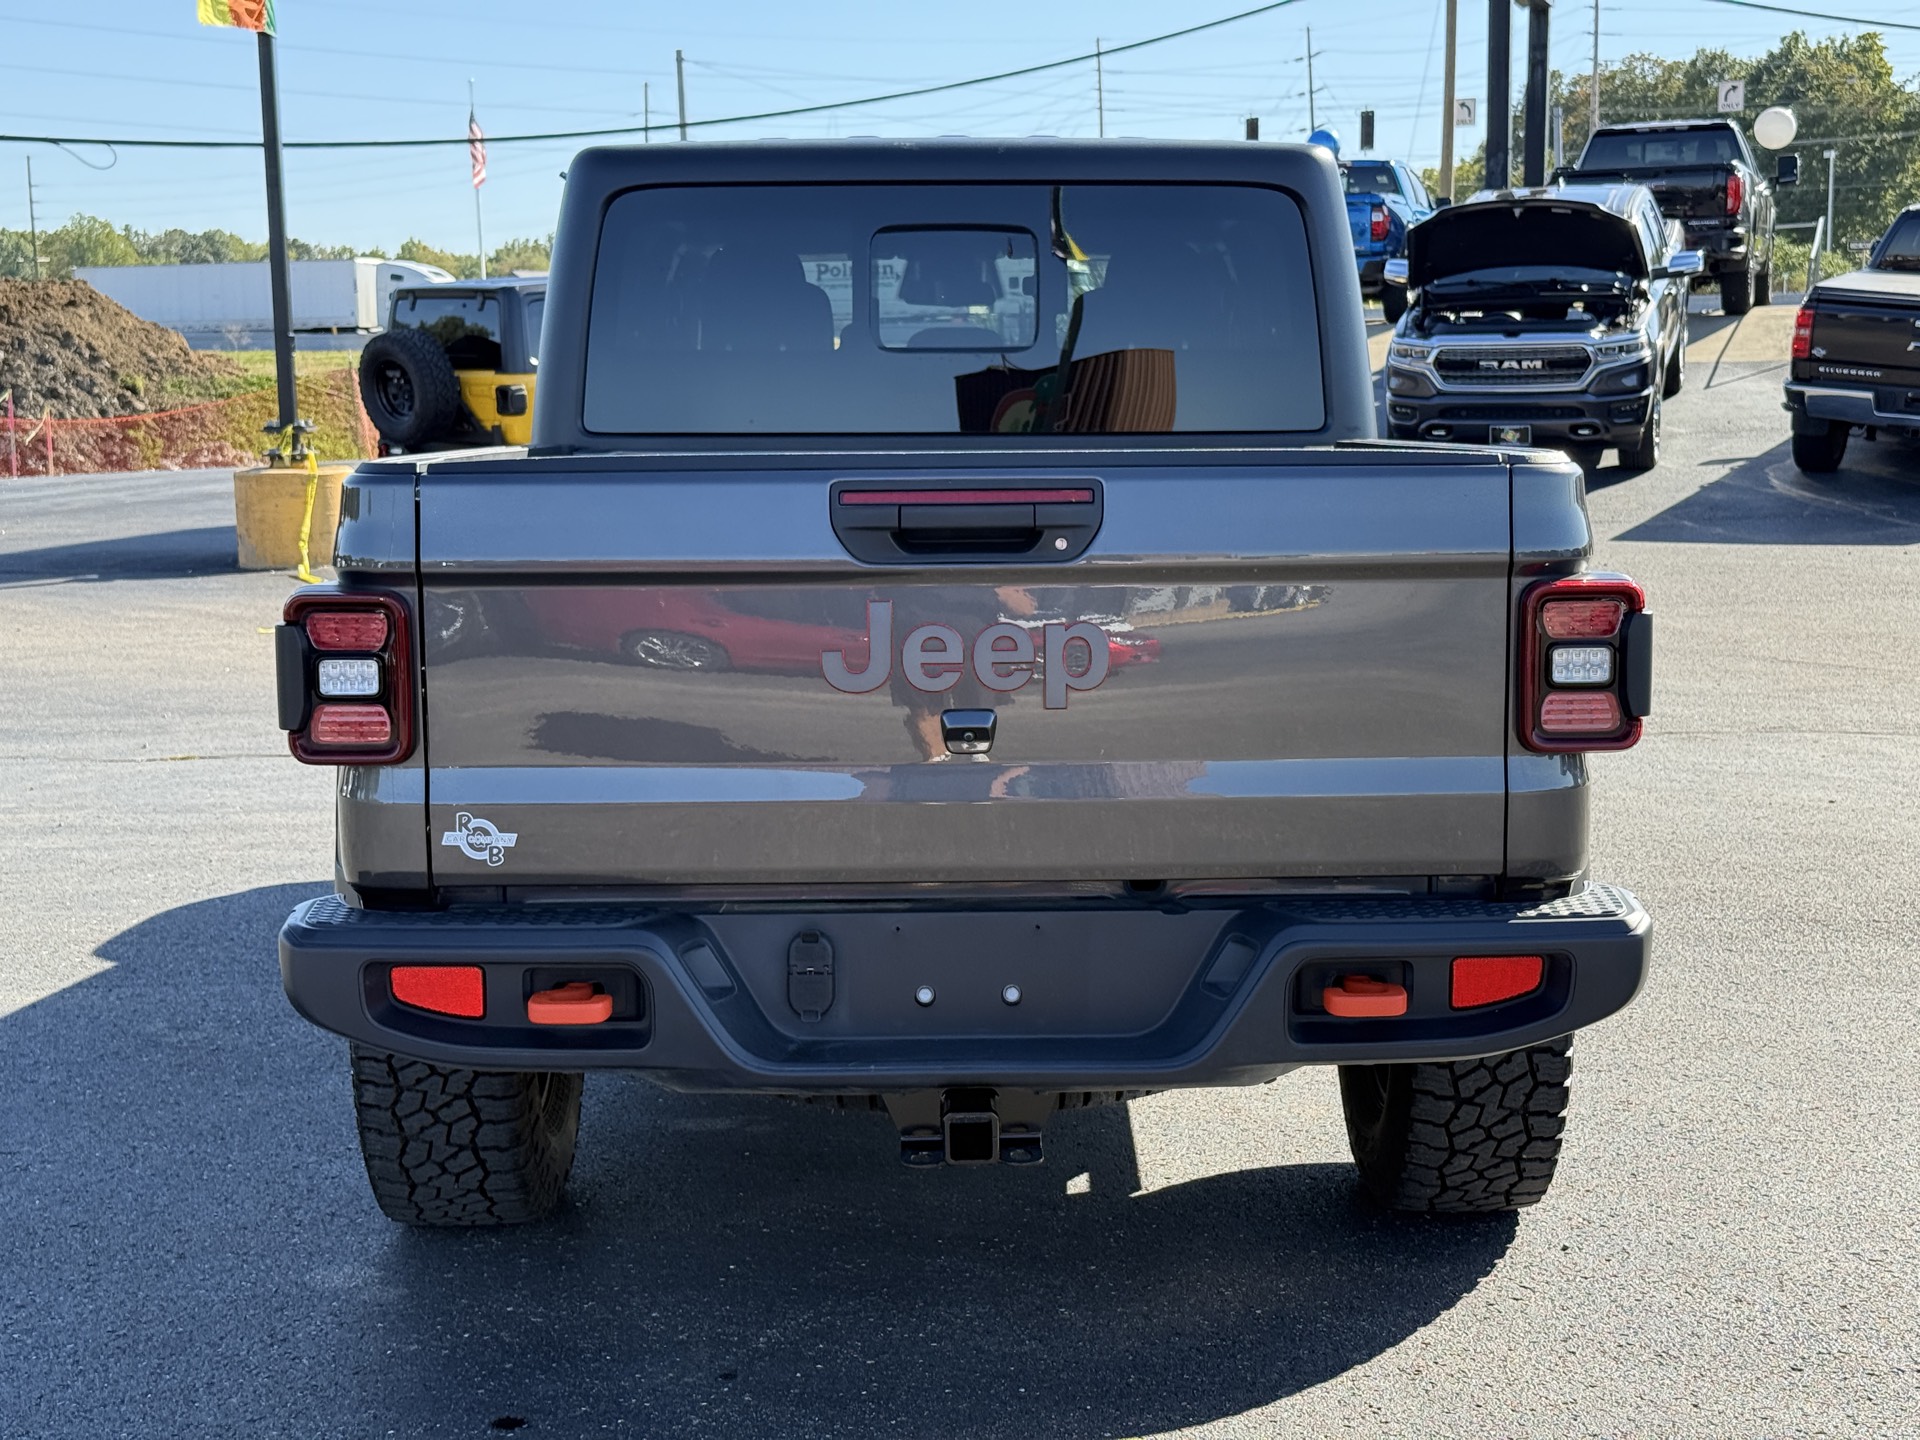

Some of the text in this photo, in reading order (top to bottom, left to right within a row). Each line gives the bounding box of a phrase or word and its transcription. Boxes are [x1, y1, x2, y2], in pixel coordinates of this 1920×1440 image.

[1721, 102, 1740, 110] ONLY
[1479, 360, 1543, 370] RAM
[820, 599, 1110, 710] Jeep
[456, 812, 473, 834] R
[487, 845, 504, 867] B
